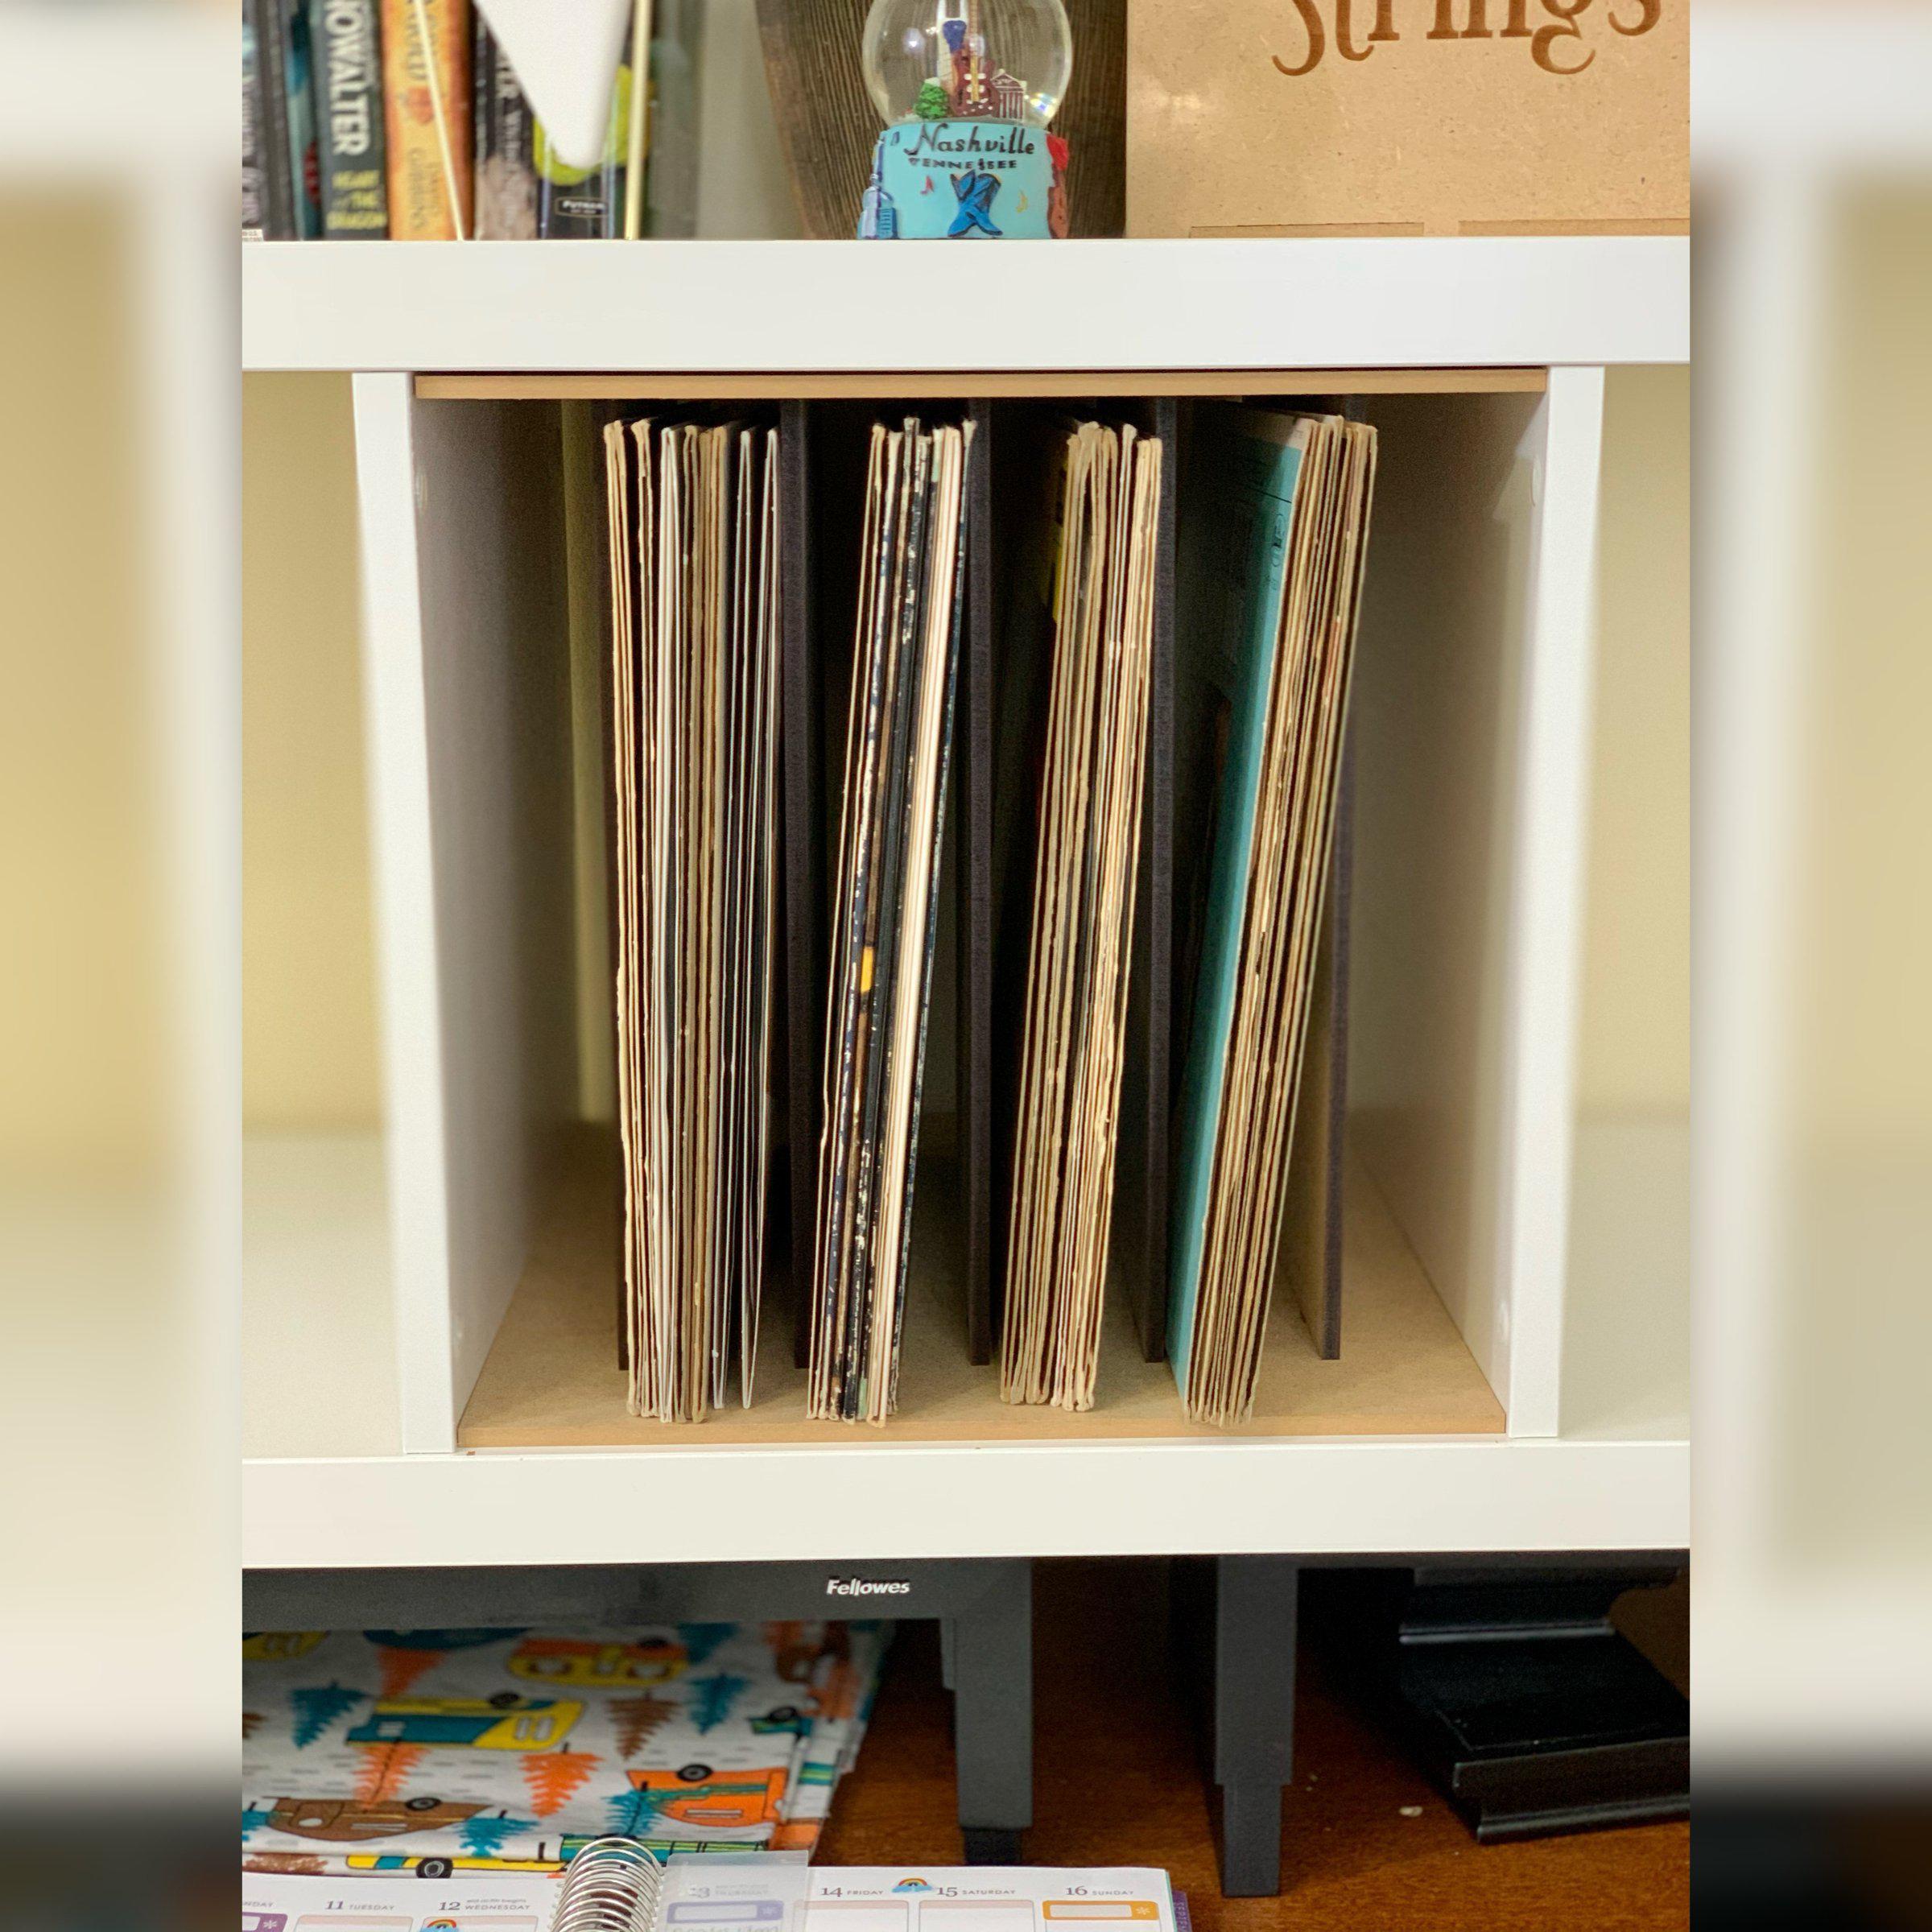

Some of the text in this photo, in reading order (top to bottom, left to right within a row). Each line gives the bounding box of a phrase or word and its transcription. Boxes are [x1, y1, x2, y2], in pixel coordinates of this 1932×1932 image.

[904, 123, 1034, 155] Nashville
[908, 158, 1017, 169] TENNESSEE
[826, 1578, 910, 1596] Fellowes
[821, 1887, 843, 1897] 14
[937, 1887, 958, 1897] 15
[1066, 1885, 1088, 1896] 16
[325, 1901, 345, 1910] 11
[439, 1901, 460, 1911] 12
